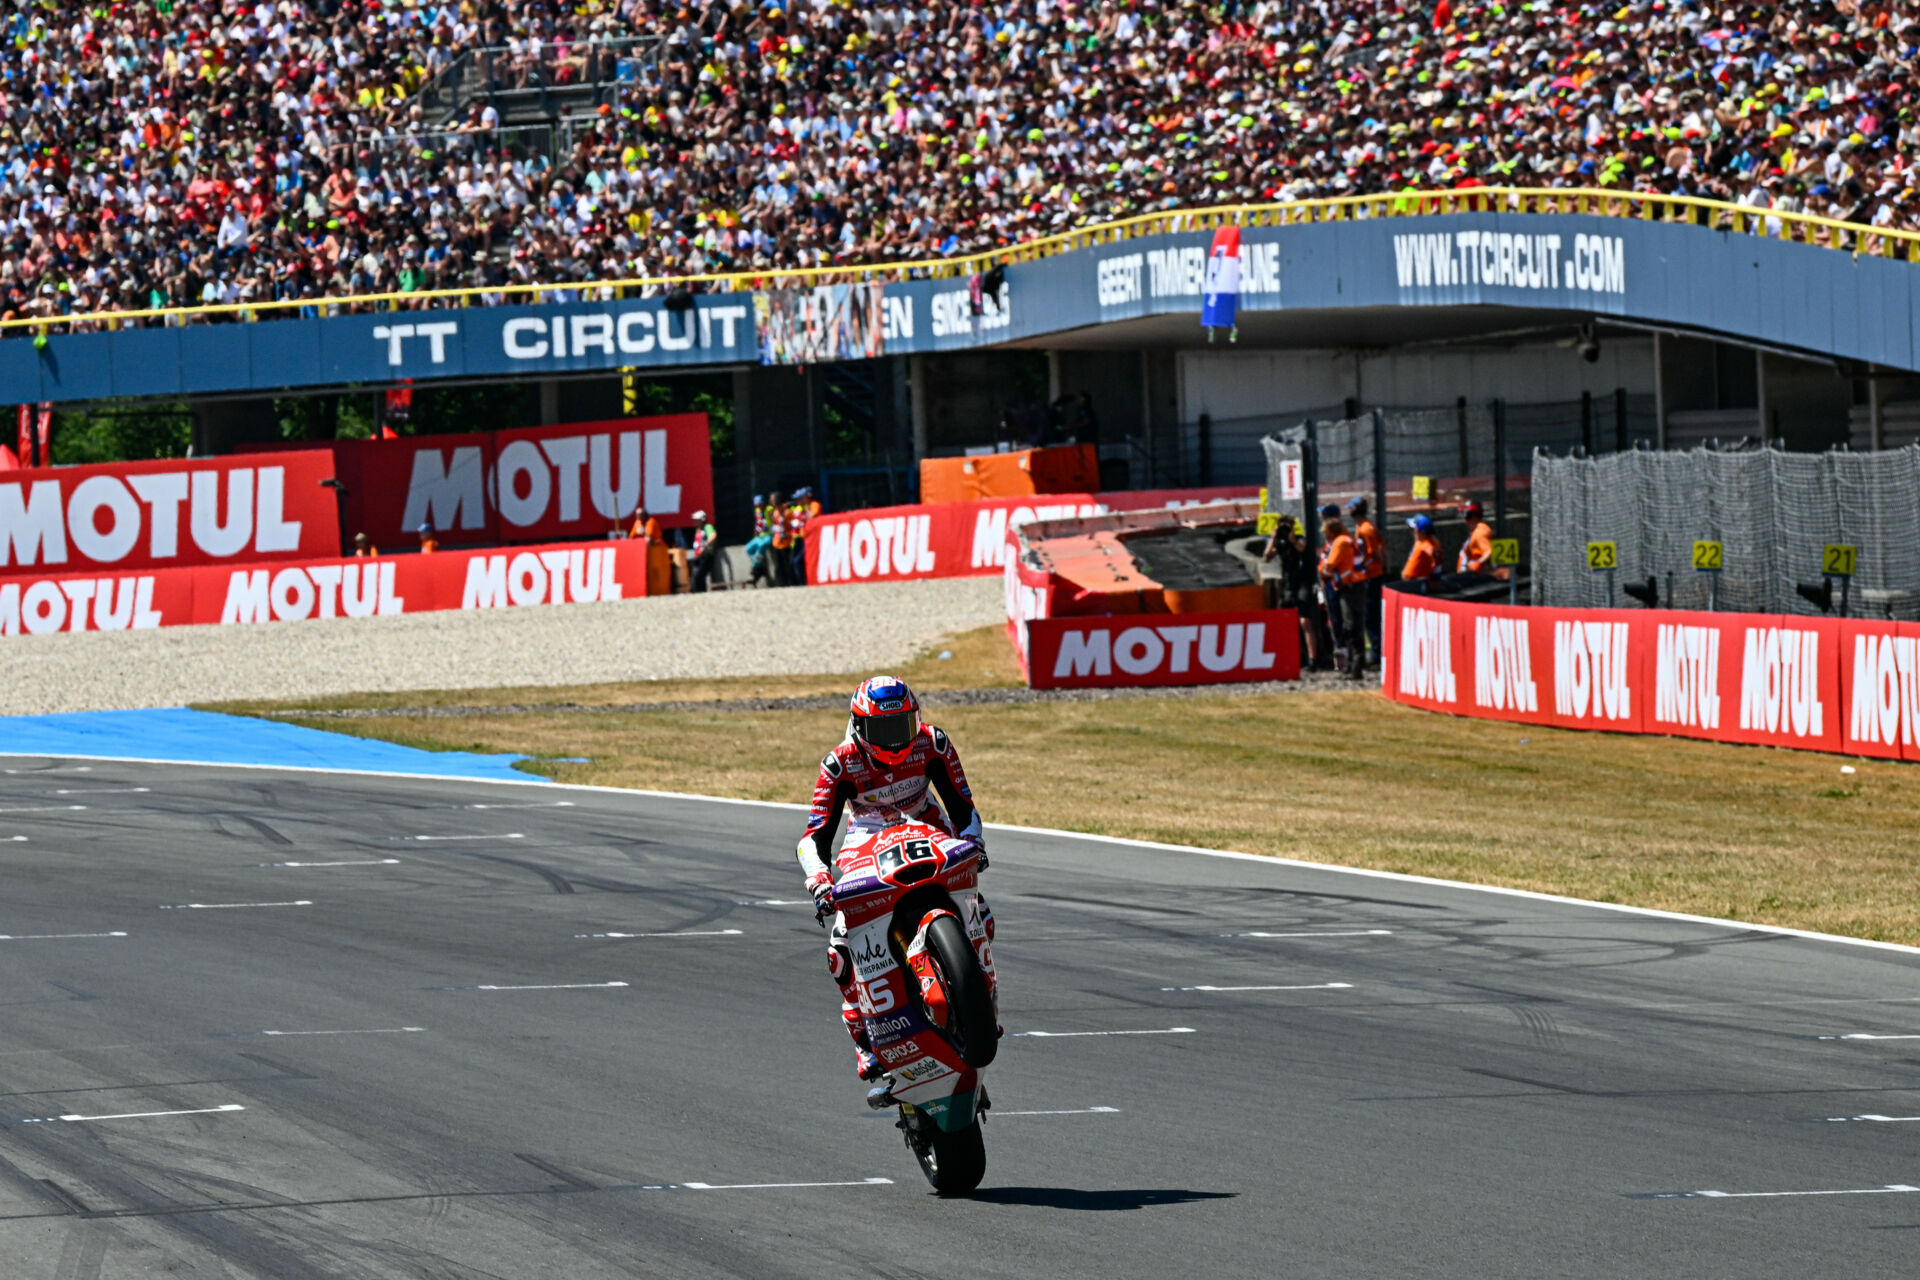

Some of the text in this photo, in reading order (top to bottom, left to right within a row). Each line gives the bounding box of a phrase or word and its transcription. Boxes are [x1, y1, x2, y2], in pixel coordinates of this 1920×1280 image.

[1098, 253, 1143, 306] GEERT
[1394, 231, 1625, 294] WWW.TTCIRCUIT.COM
[373, 321, 458, 366] TT
[502, 305, 747, 360] CIRCUIT
[401, 429, 682, 532] MOTUL
[0, 466, 302, 566] MOTUL
[817, 514, 936, 583] MOTUL
[1495, 542, 1516, 563] 24
[1590, 545, 1614, 568] 23
[1696, 544, 1720, 567] 22
[1828, 548, 1852, 572] 21
[220, 562, 404, 625] MOTUL
[462, 547, 623, 609] MOTUL
[1053, 622, 1276, 678] MOTUL
[1400, 607, 1456, 703] MOTUL
[1475, 616, 1538, 712] MOTUL
[1555, 620, 1630, 719] MOTUL
[1655, 624, 1720, 729] MOTUL
[1740, 627, 1823, 737] MOTUL
